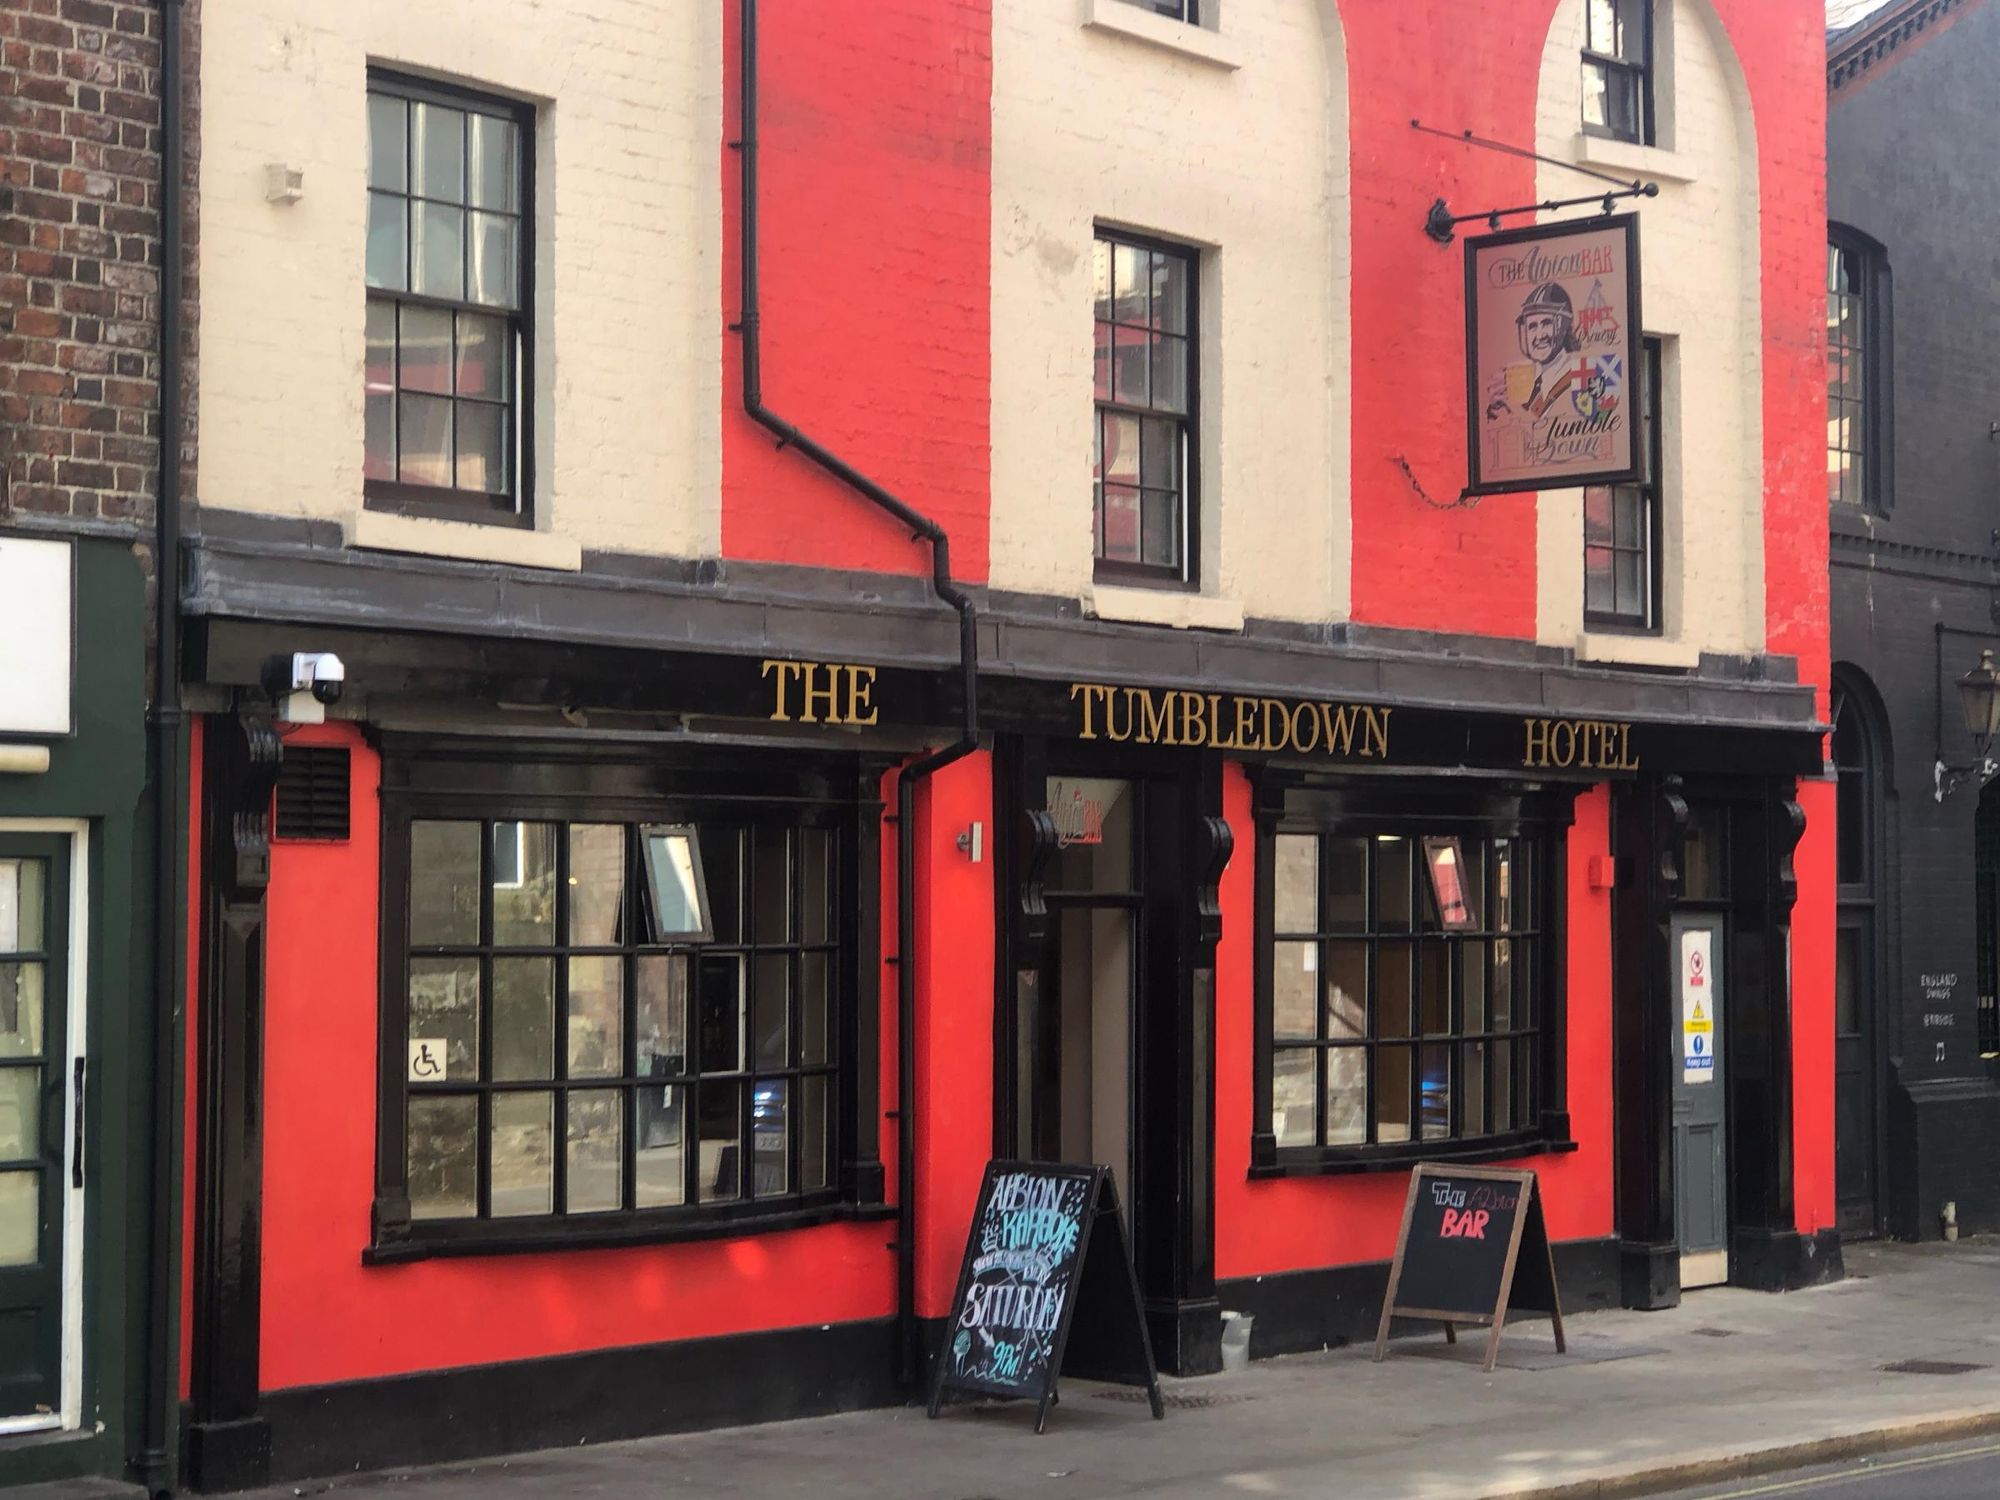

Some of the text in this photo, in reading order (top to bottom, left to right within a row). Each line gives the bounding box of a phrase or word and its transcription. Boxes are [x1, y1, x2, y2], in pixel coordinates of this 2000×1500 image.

[1580, 245, 1614, 277] BAR
[762, 659, 1640, 771] THE TUMBLEDOWN HOTEL
[986, 1173, 1070, 1215] ALBION
[1001, 1211, 1080, 1266] KARAOKE
[1440, 1208, 1490, 1239] BAR
[960, 1283, 1066, 1331] SATURDAY
[989, 1340, 1020, 1377] 9PM
